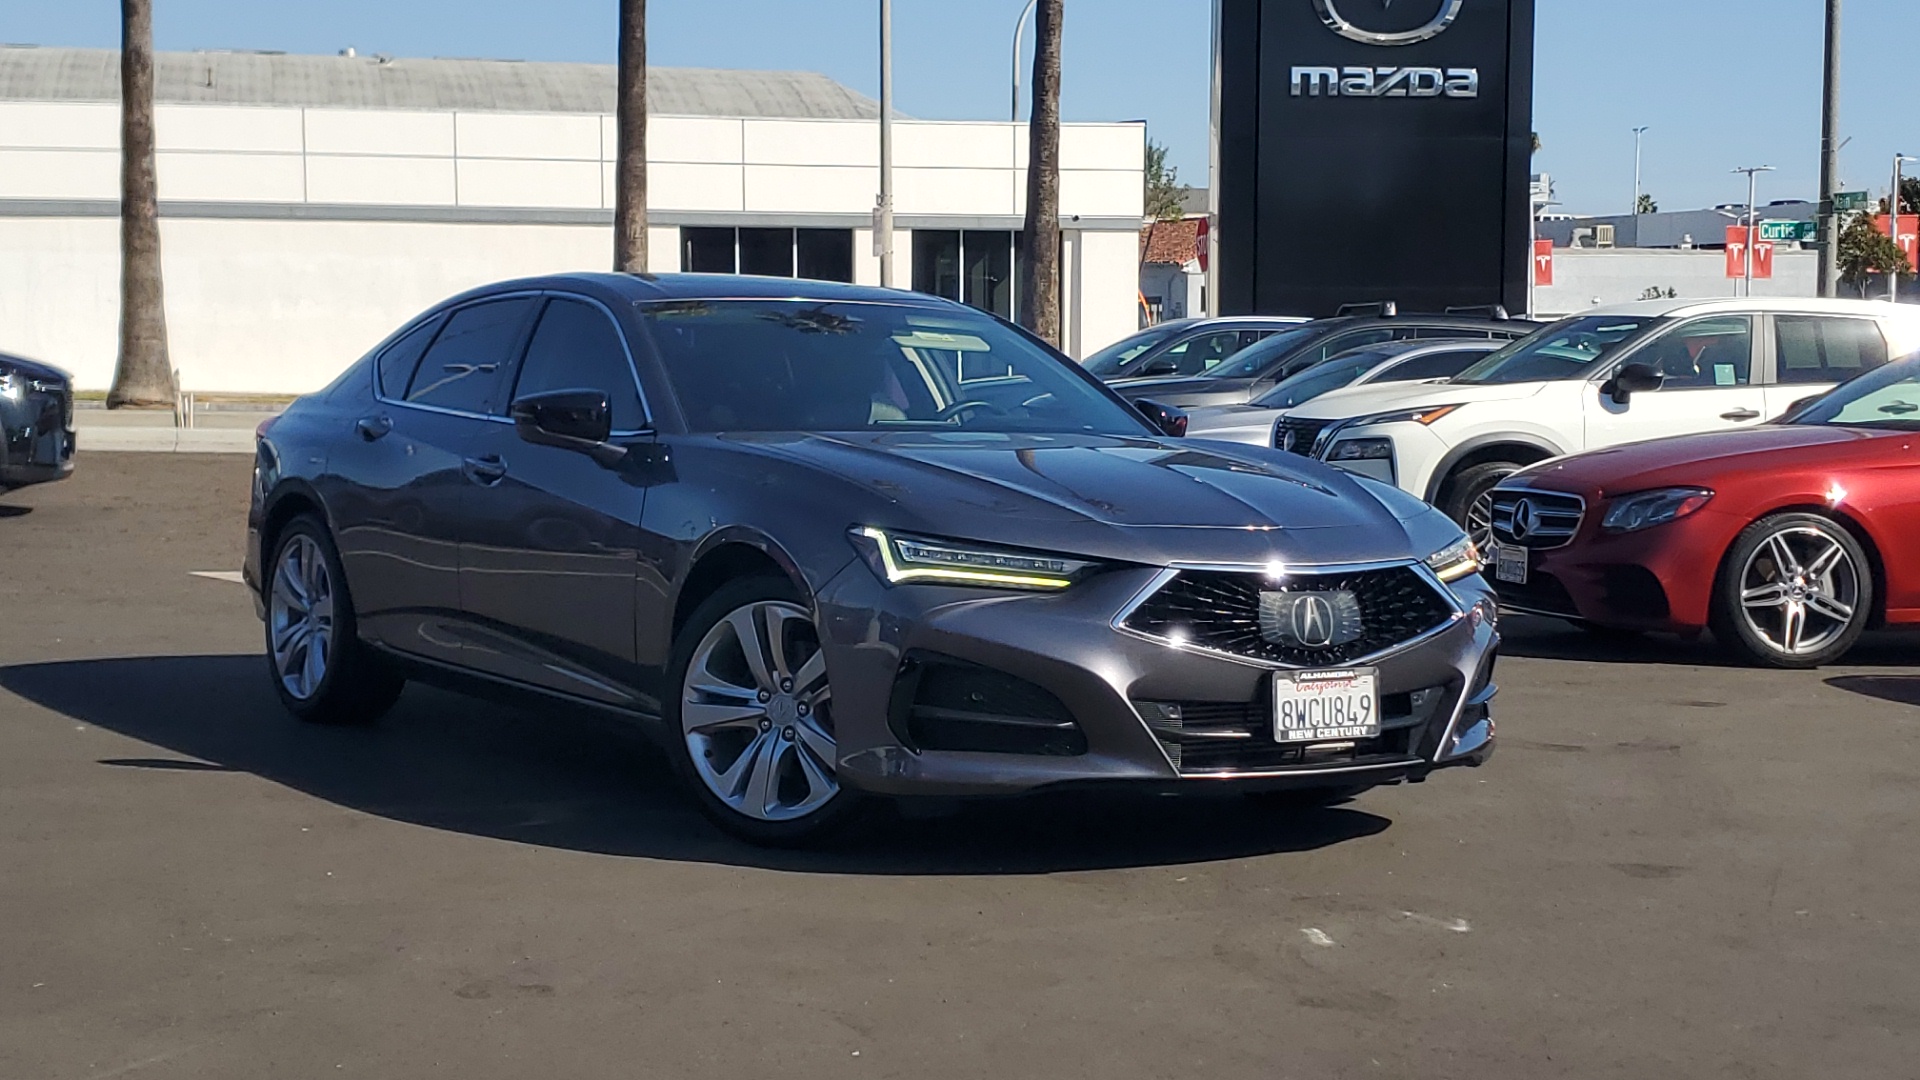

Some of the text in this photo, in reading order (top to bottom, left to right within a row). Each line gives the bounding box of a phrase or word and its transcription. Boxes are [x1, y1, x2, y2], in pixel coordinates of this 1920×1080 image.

[1291, 66, 1478, 97] mazda
[1761, 223, 1795, 238] Curtis
[1300, 671, 1354, 680] ALHAMBRA
[1282, 695, 1371, 729] 8WCU849
[1288, 726, 1368, 740] NEW CENTURY
